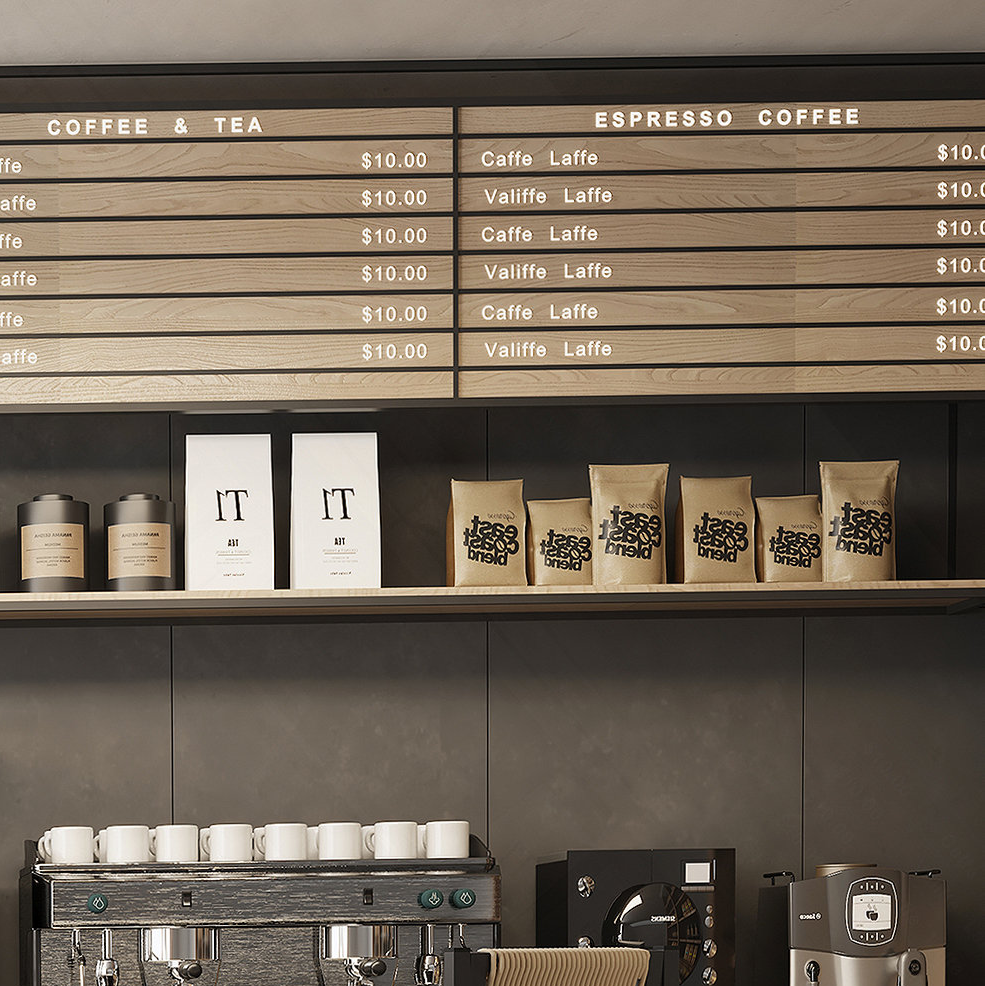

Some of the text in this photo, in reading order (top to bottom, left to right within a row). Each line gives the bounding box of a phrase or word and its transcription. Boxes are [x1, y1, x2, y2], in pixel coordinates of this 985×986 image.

[47, 116, 263, 136] COFFEE & TEA
[595, 108, 859, 128] ESPRESSO COFFEE
[361, 151, 427, 170] $10.00
[481, 150, 533, 167] Caffe
[550, 149, 598, 166] Laffe
[361, 189, 427, 208] $10.00
[484, 187, 547, 205] Valiffe
[564, 186, 612, 203] Laffe
[361, 227, 427, 246] $10.00
[481, 226, 533, 243] Caffe
[550, 225, 598, 242] Laffe
[361, 265, 427, 283] $10.00
[484, 263, 547, 280] Valiffe
[564, 262, 612, 279] Laffe
[362, 305, 427, 324] $10.00
[481, 304, 533, 321] Caffe
[550, 303, 598, 320] Laffe
[362, 343, 427, 361] $10.00
[484, 341, 547, 358] Valiffe
[564, 340, 612, 357] Laffe
